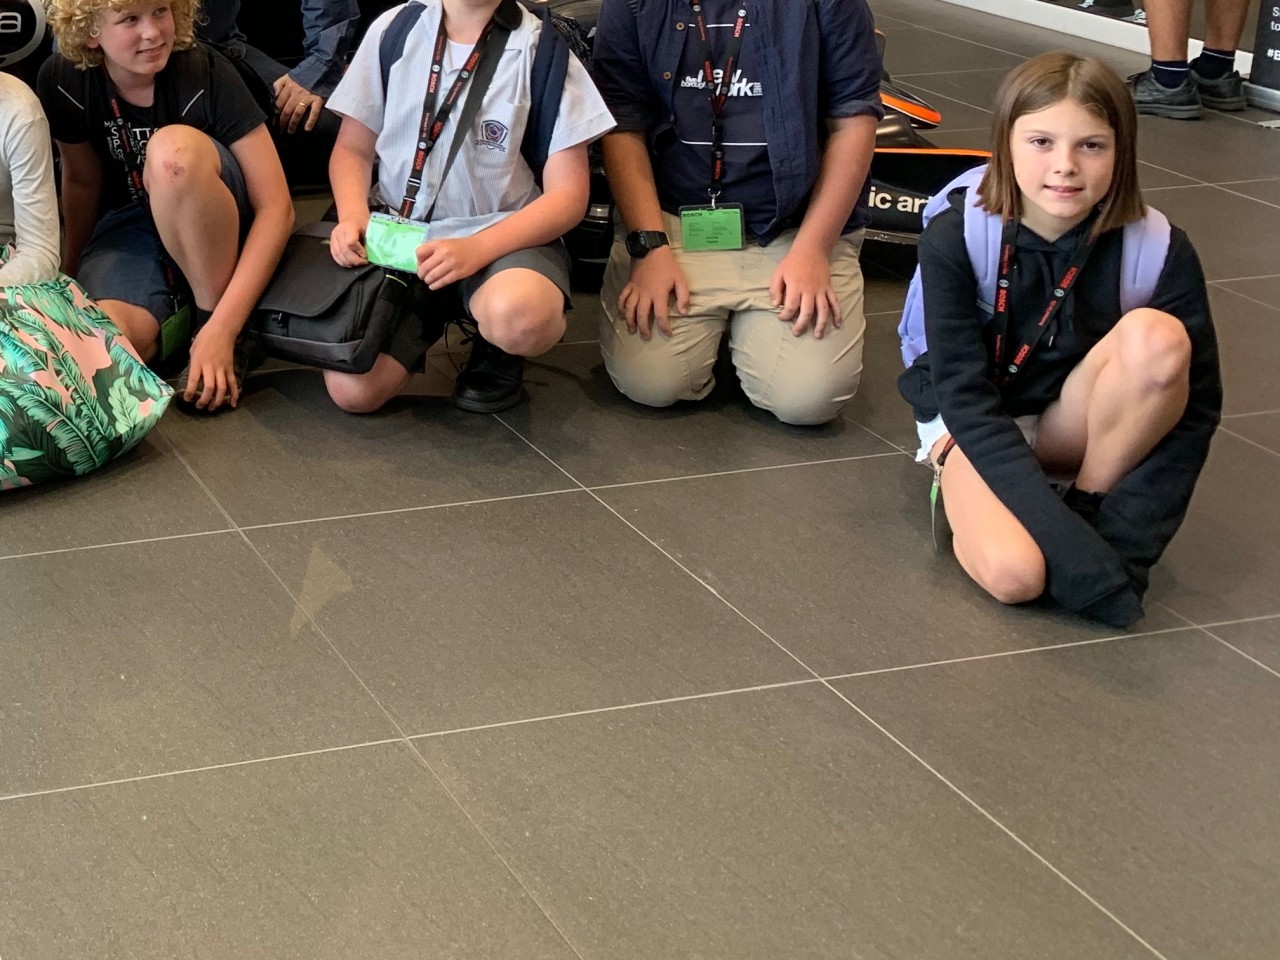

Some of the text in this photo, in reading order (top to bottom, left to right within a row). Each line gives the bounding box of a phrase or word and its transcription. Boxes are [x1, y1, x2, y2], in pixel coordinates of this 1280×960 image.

[734, 18, 744, 37] BOSCH
[466, 52, 480, 69] BOSCH
[429, 73, 438, 93] BOSCH
[416, 150, 425, 171] BOSCH
[868, 186, 892, 209] ic
[1060, 266, 1079, 289] BOSCH
[997, 289, 1007, 313] BOSCH
[1014, 343, 1030, 365] BOSCH
